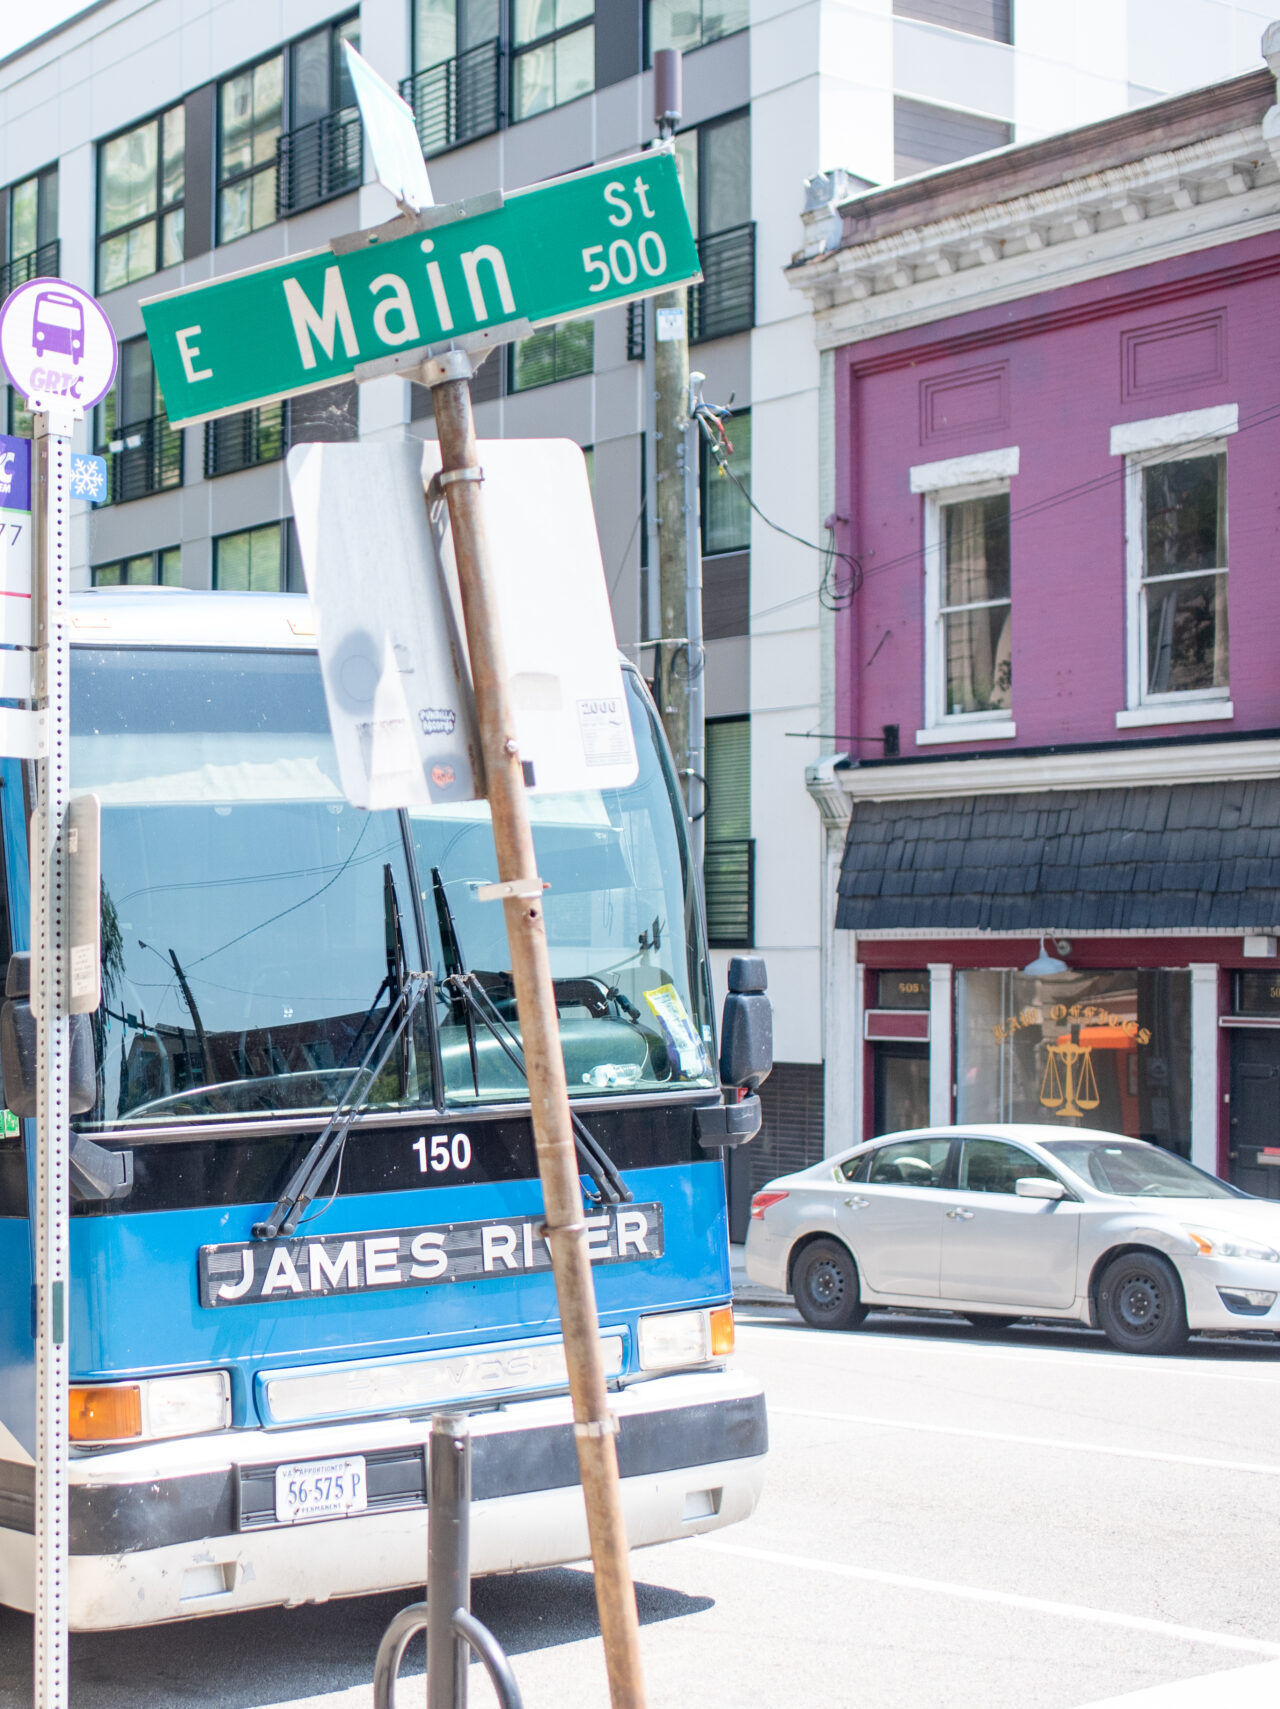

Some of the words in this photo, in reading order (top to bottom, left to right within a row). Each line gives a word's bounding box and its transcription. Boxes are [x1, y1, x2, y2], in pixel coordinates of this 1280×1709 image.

[603, 176, 656, 227] St
[582, 230, 668, 293] 500
[175, 325, 213, 383] E
[282, 238, 517, 370] Main
[29, 366, 84, 400] GRTC
[412, 1133, 472, 1172] 150
[218, 1231, 448, 1300] JAMES
[481, 1210, 649, 1273] RIER
[288, 1475, 344, 1504] 56-575
[351, 1472, 361, 1497] P
[299, 1463, 343, 1475] APPORTIONED
[300, 1503, 341, 1514] PERMANENT
